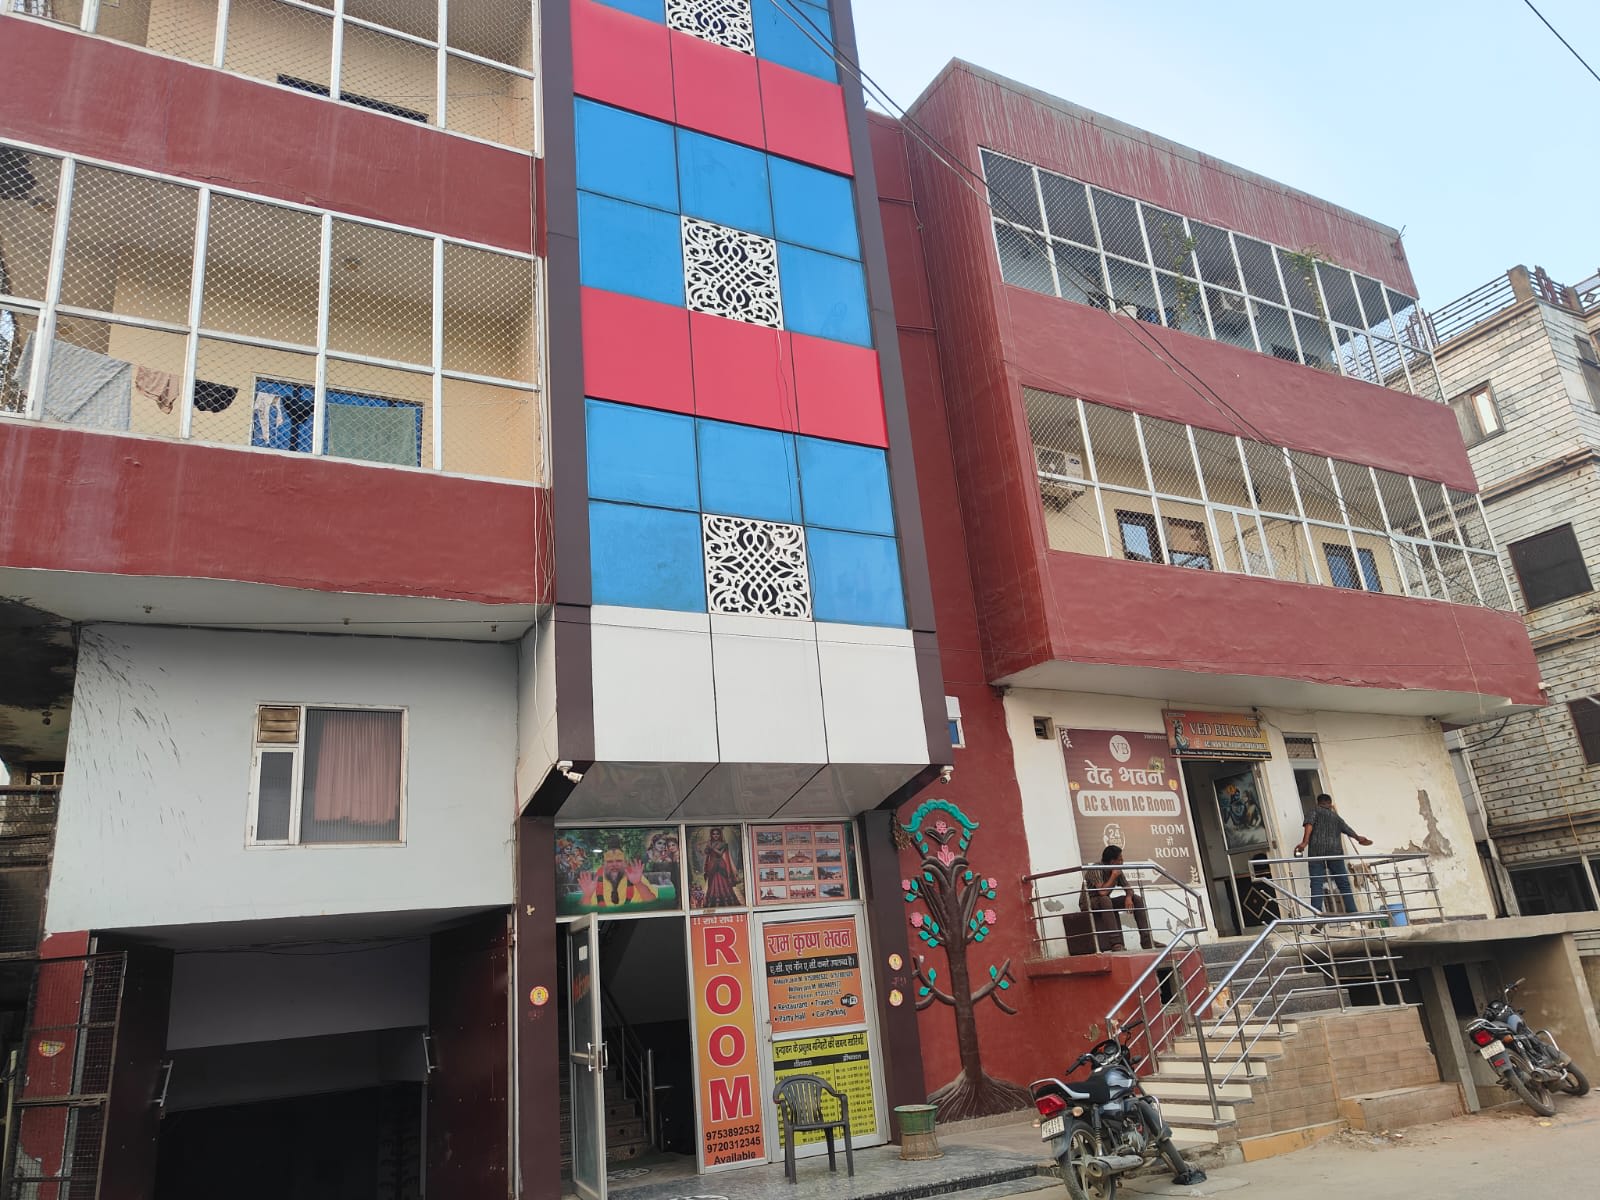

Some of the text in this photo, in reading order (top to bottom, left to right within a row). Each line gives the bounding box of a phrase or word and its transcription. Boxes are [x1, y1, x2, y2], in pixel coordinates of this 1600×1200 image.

[1189, 722, 1212, 735] VED
[1111, 742, 1129, 754] VB
[1084, 759, 1165, 788] वेद भवन
[1083, 795, 1176, 812] AC & Non AC Room
[1108, 829, 1121, 838] 24
[1151, 824, 1185, 835] ROOM
[1155, 847, 1190, 858] ROOM
[767, 929, 851, 957] राम कृष्ण भवन
[778, 1002, 808, 1011] Restaurant
[795, 1012, 806, 1020] Hall
[703, 926, 753, 1122] ROOM
[706, 1124, 760, 1140] 9753892532
[707, 1136, 761, 1153] 9720312345
[714, 1151, 756, 1166] Available
